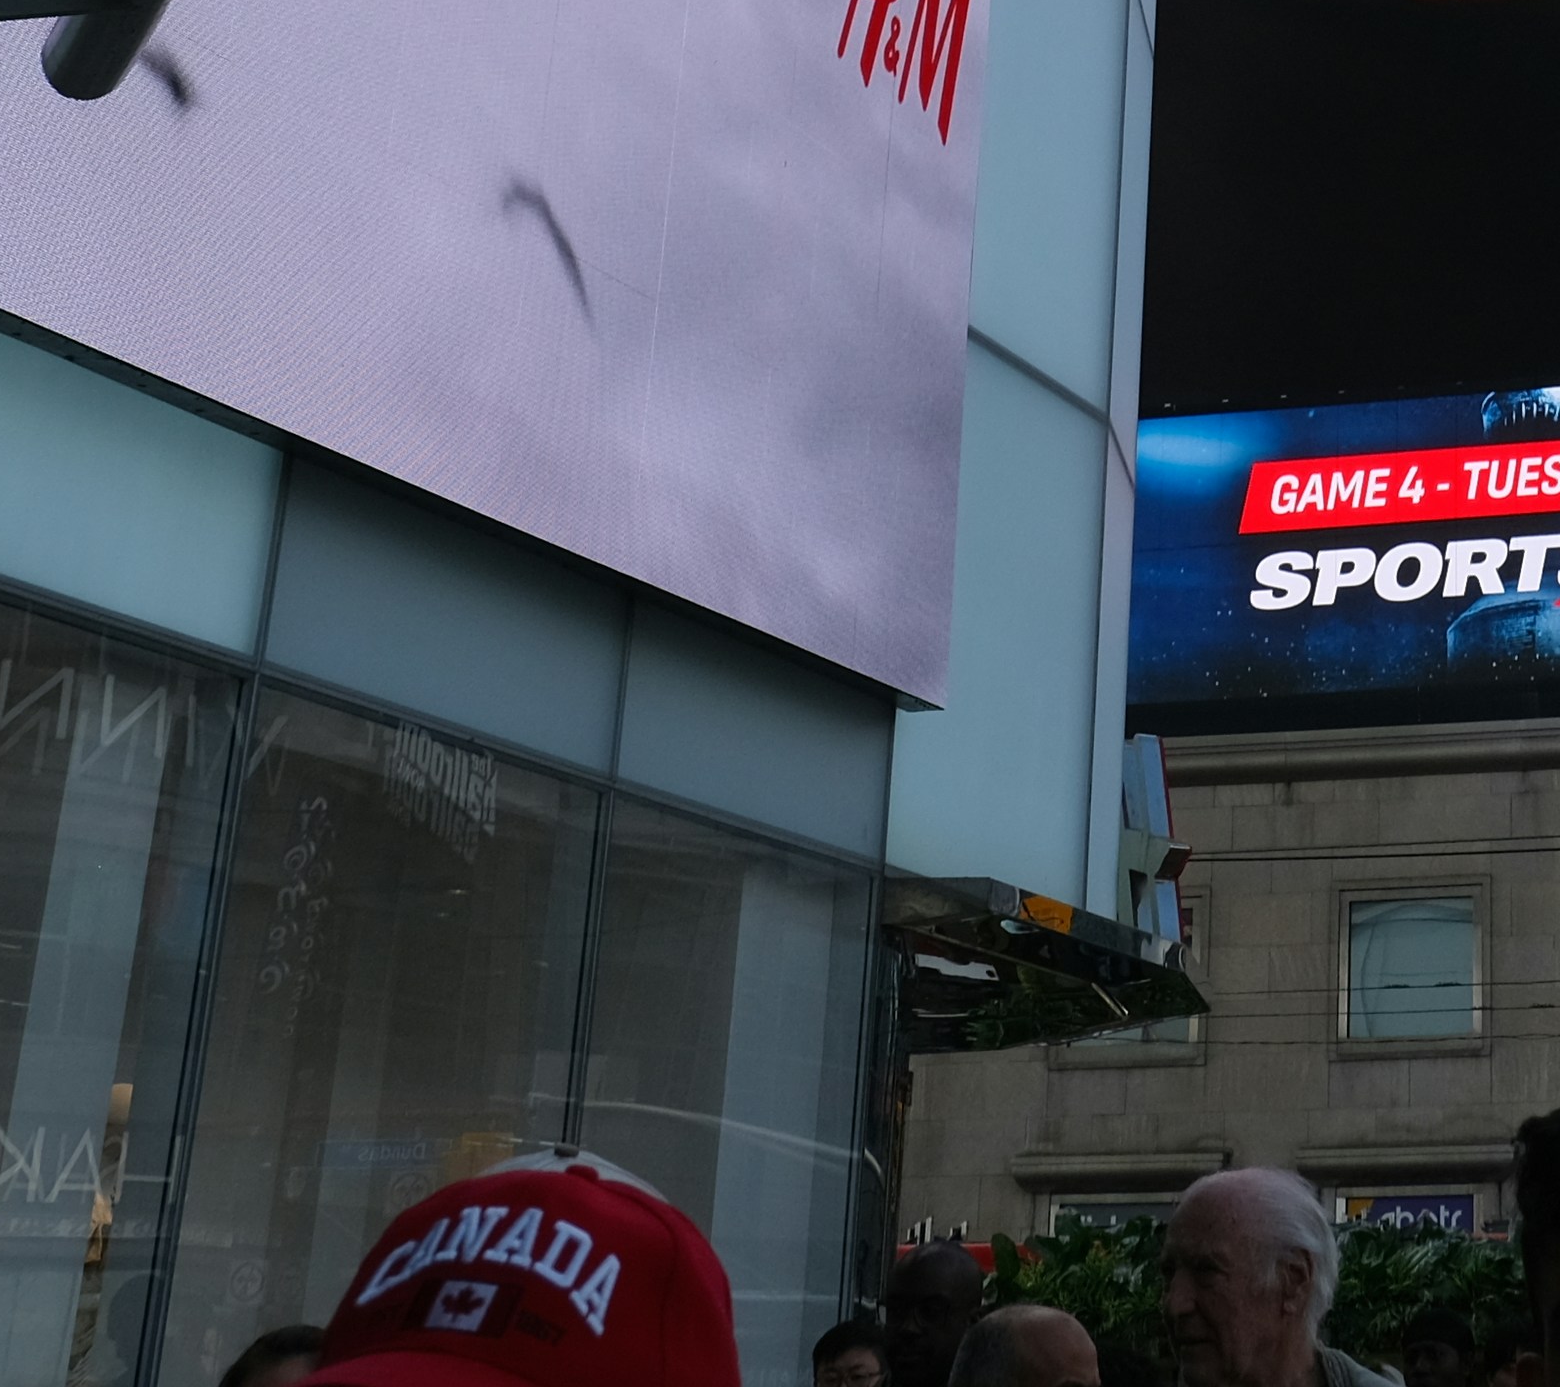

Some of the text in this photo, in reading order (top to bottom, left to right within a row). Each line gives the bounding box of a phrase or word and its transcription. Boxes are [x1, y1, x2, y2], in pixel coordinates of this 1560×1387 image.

[1269, 467, 1389, 516] GAME
[1398, 467, 1425, 507] 4
[355, 1205, 622, 1338] CANADA
